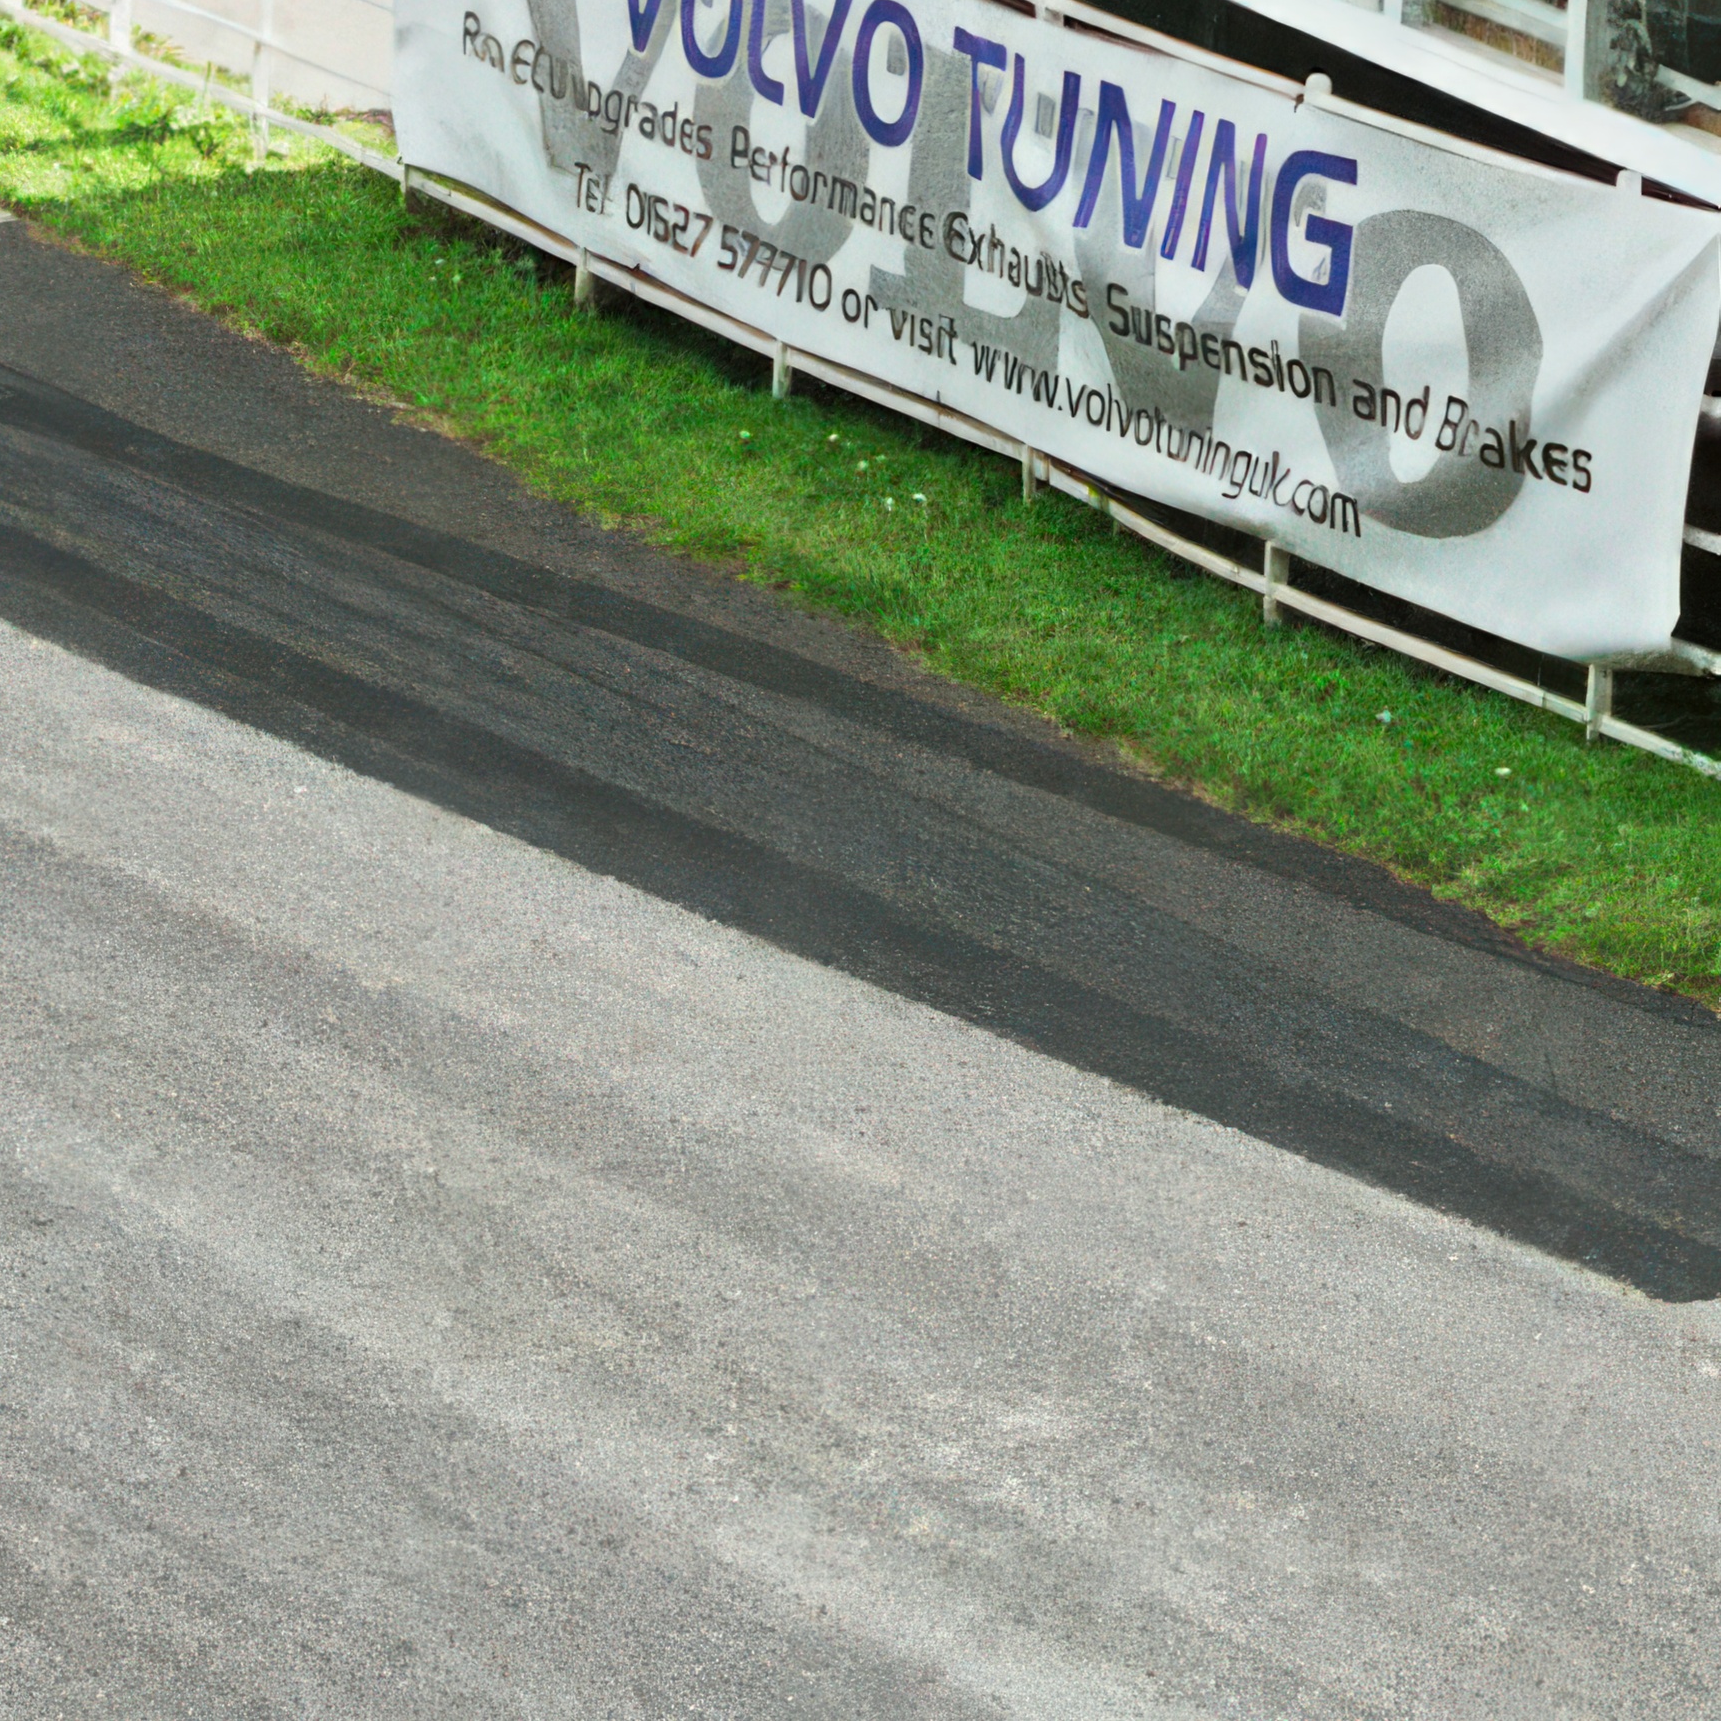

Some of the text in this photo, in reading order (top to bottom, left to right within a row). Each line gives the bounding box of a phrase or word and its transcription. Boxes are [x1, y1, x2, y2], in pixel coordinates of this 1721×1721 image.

[625, 182, 714, 258] 01527
[841, 287, 879, 330] or
[889, 306, 958, 366] visit
[730, 124, 936, 250] Performance
[942, 210, 1090, 319] Exhausts
[1106, 282, 1337, 408] Suspension
[1352, 379, 1431, 441] and
[1434, 395, 1593, 494] Brakes
[952, 24, 1358, 318] TUNING
